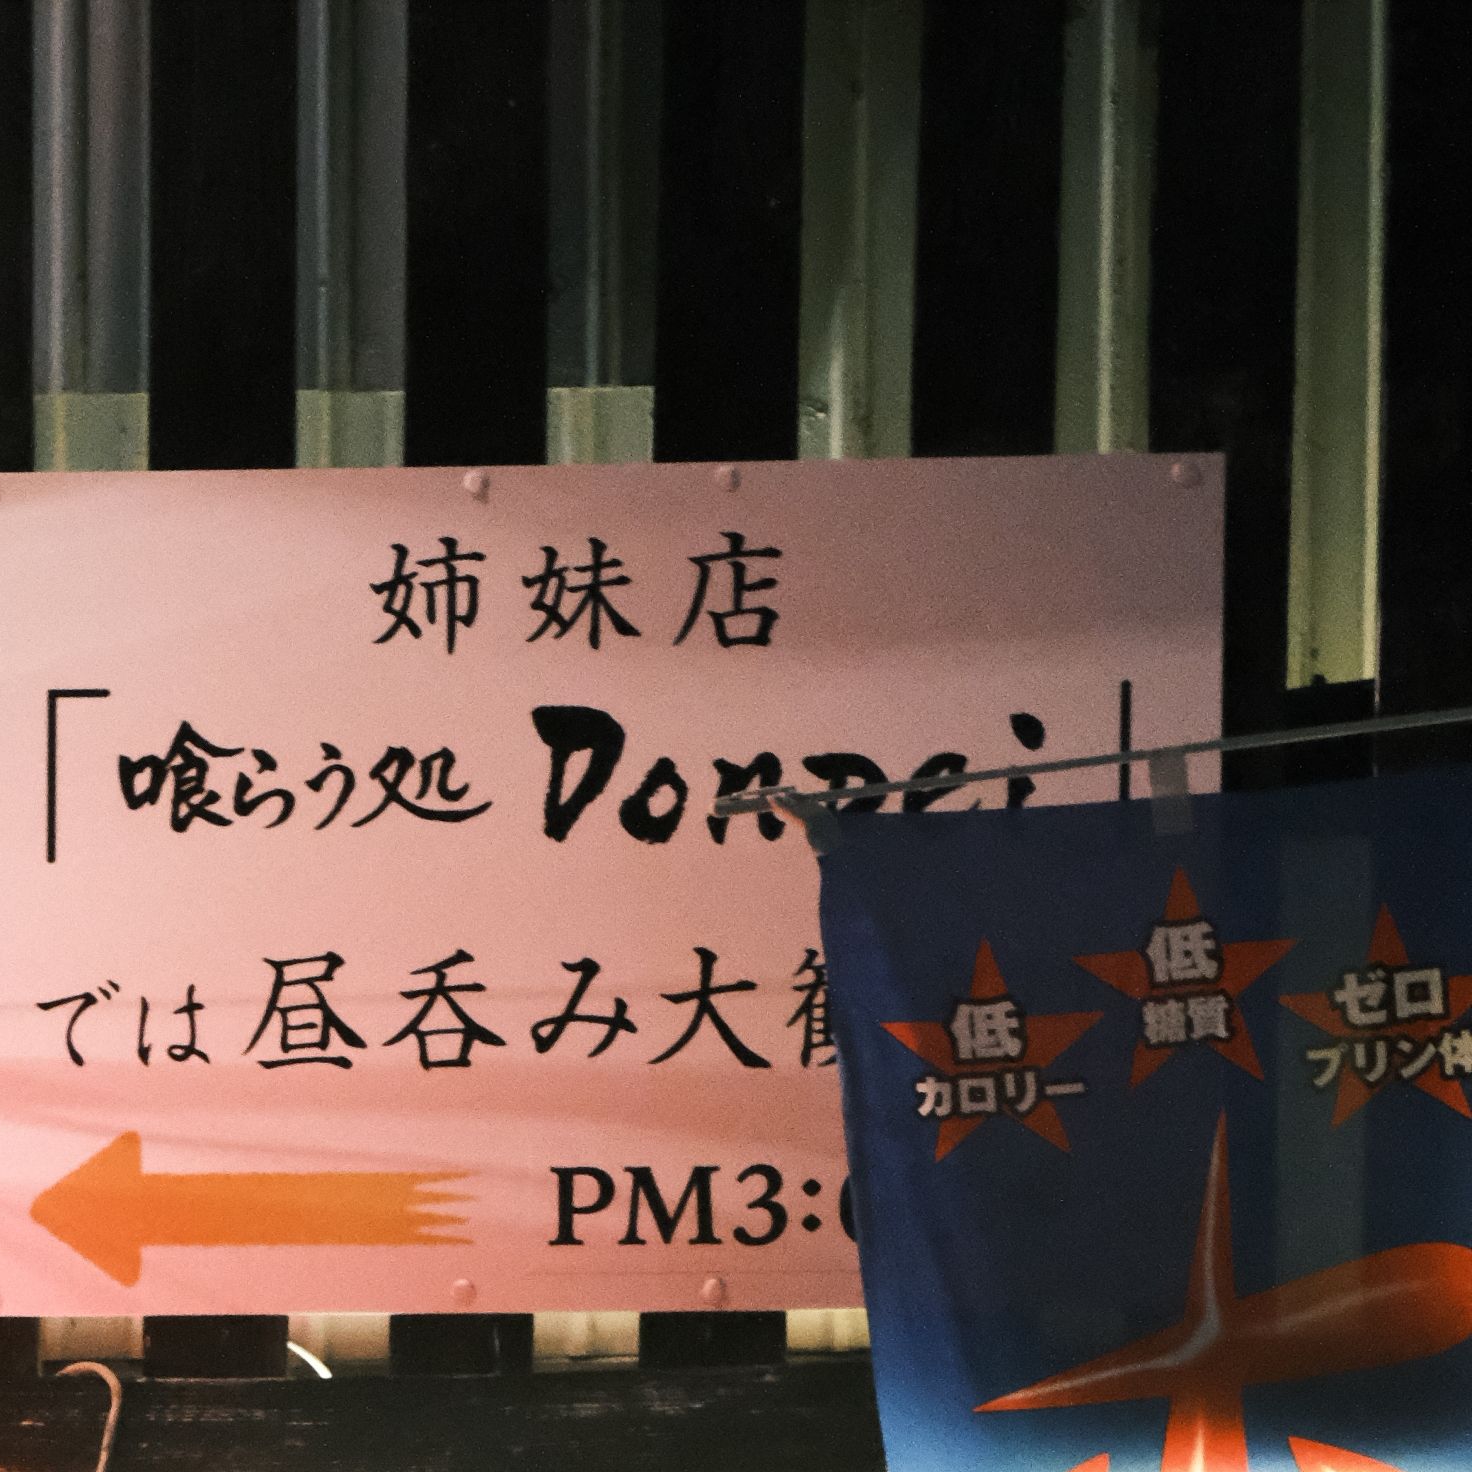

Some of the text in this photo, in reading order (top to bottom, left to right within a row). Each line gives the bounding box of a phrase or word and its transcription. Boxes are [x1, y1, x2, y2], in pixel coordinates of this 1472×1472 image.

[369, 531, 783, 655] 姉妹店
[1145, 920, 1219, 983] 低
[1141, 993, 1230, 1045] 糖質
[1334, 967, 1445, 1027] ゼロ
[948, 1000, 1023, 1061] 低
[915, 1072, 1086, 1118] カロリー
[548, 1164, 861, 1248] PM3:
